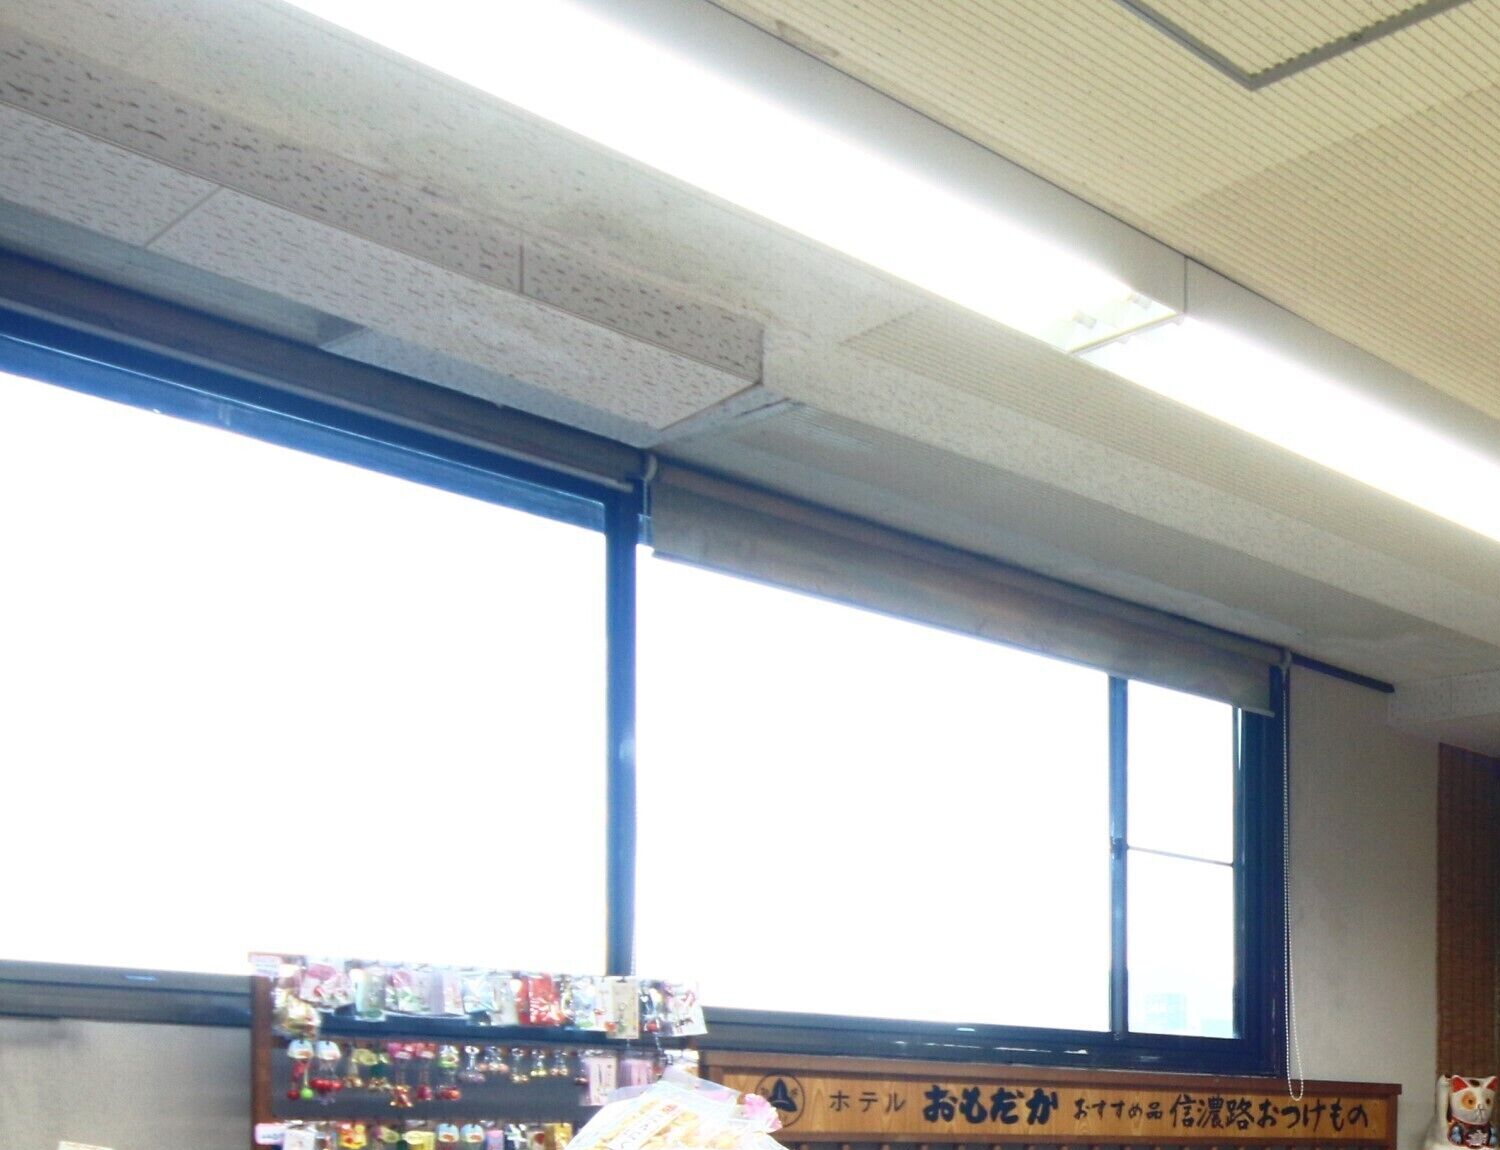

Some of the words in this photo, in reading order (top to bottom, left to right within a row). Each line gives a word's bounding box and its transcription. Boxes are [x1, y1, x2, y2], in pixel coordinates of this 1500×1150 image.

[829, 1090, 906, 1113] ホテル
[923, 1085, 1059, 1125] おもだか
[1074, 1097, 1163, 1121] おすすめ品
[1169, 1093, 1369, 1133] 信濃路おつけもの
